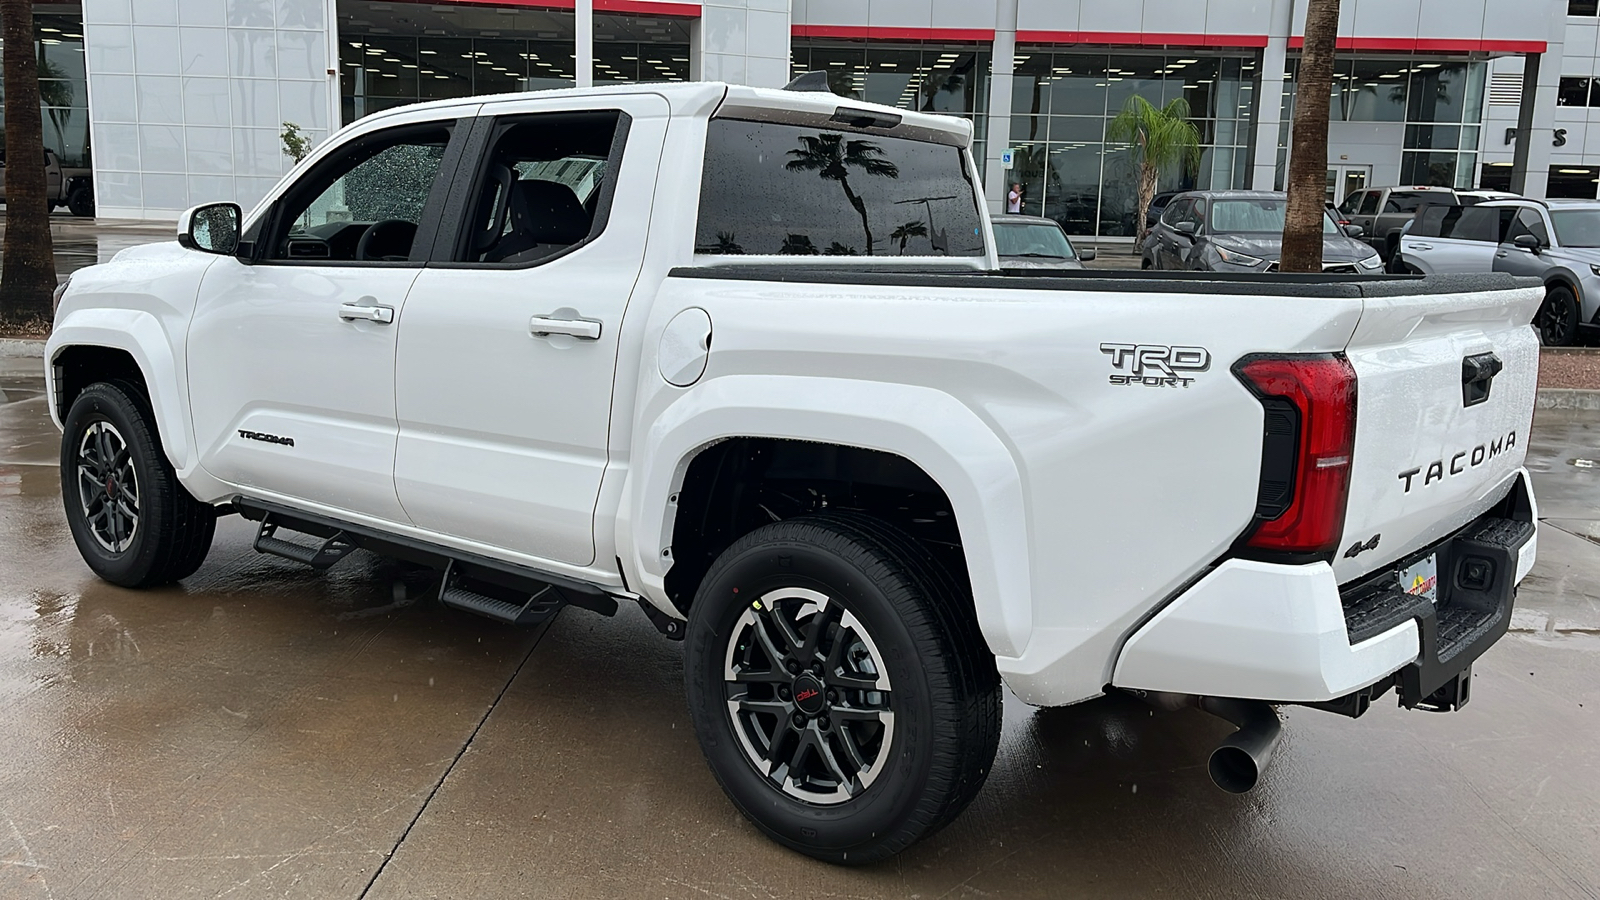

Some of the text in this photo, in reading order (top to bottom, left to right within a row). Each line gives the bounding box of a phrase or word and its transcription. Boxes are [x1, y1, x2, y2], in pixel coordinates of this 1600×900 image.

[1100, 342, 1212, 376] TRD
[1109, 374, 1195, 388] SPORT
[237, 429, 295, 447] TACOMA
[1398, 430, 1516, 493] TACOMA
[796, 688, 819, 702] TRD
